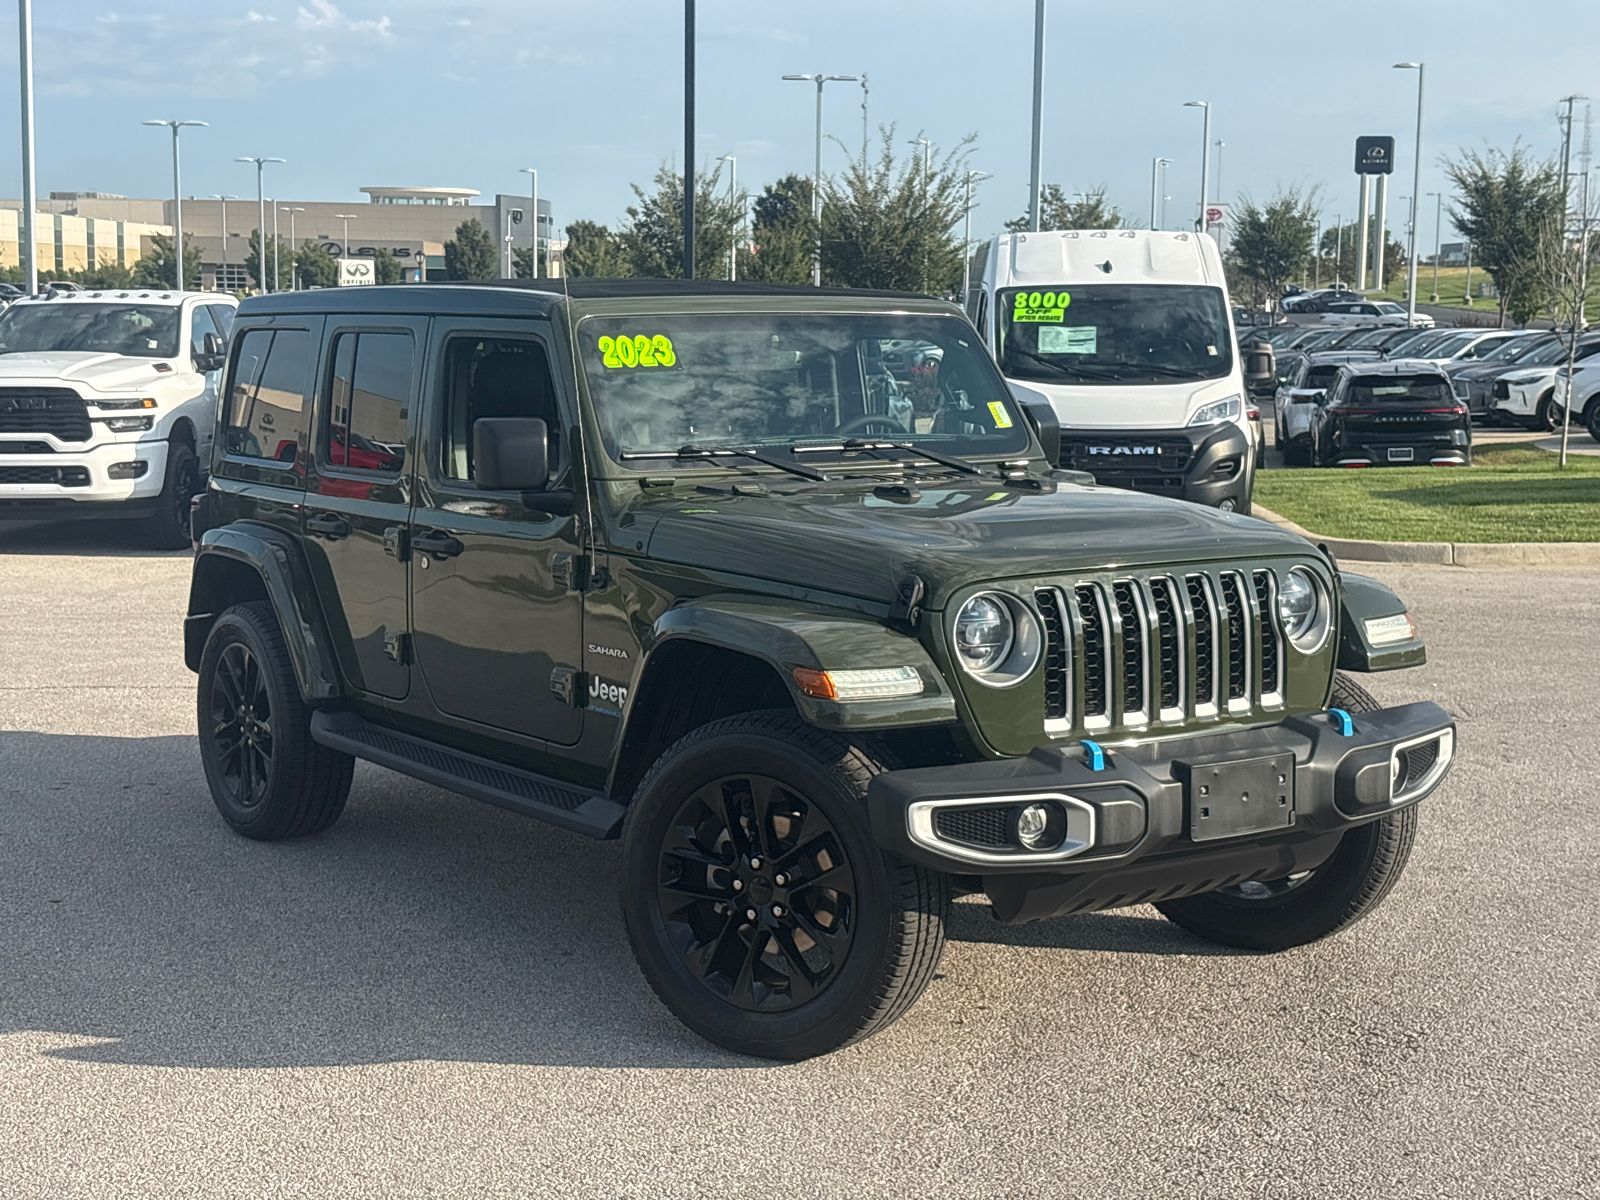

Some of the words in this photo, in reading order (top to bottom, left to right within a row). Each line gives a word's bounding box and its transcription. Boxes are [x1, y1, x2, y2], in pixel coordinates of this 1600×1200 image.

[346, 246, 411, 257] LEUS
[1014, 291, 1071, 309] 8000
[598, 334, 676, 368] 2023
[1089, 446, 1155, 455] RAM
[588, 644, 628, 659] SAHARA
[588, 675, 628, 708] Jeep
